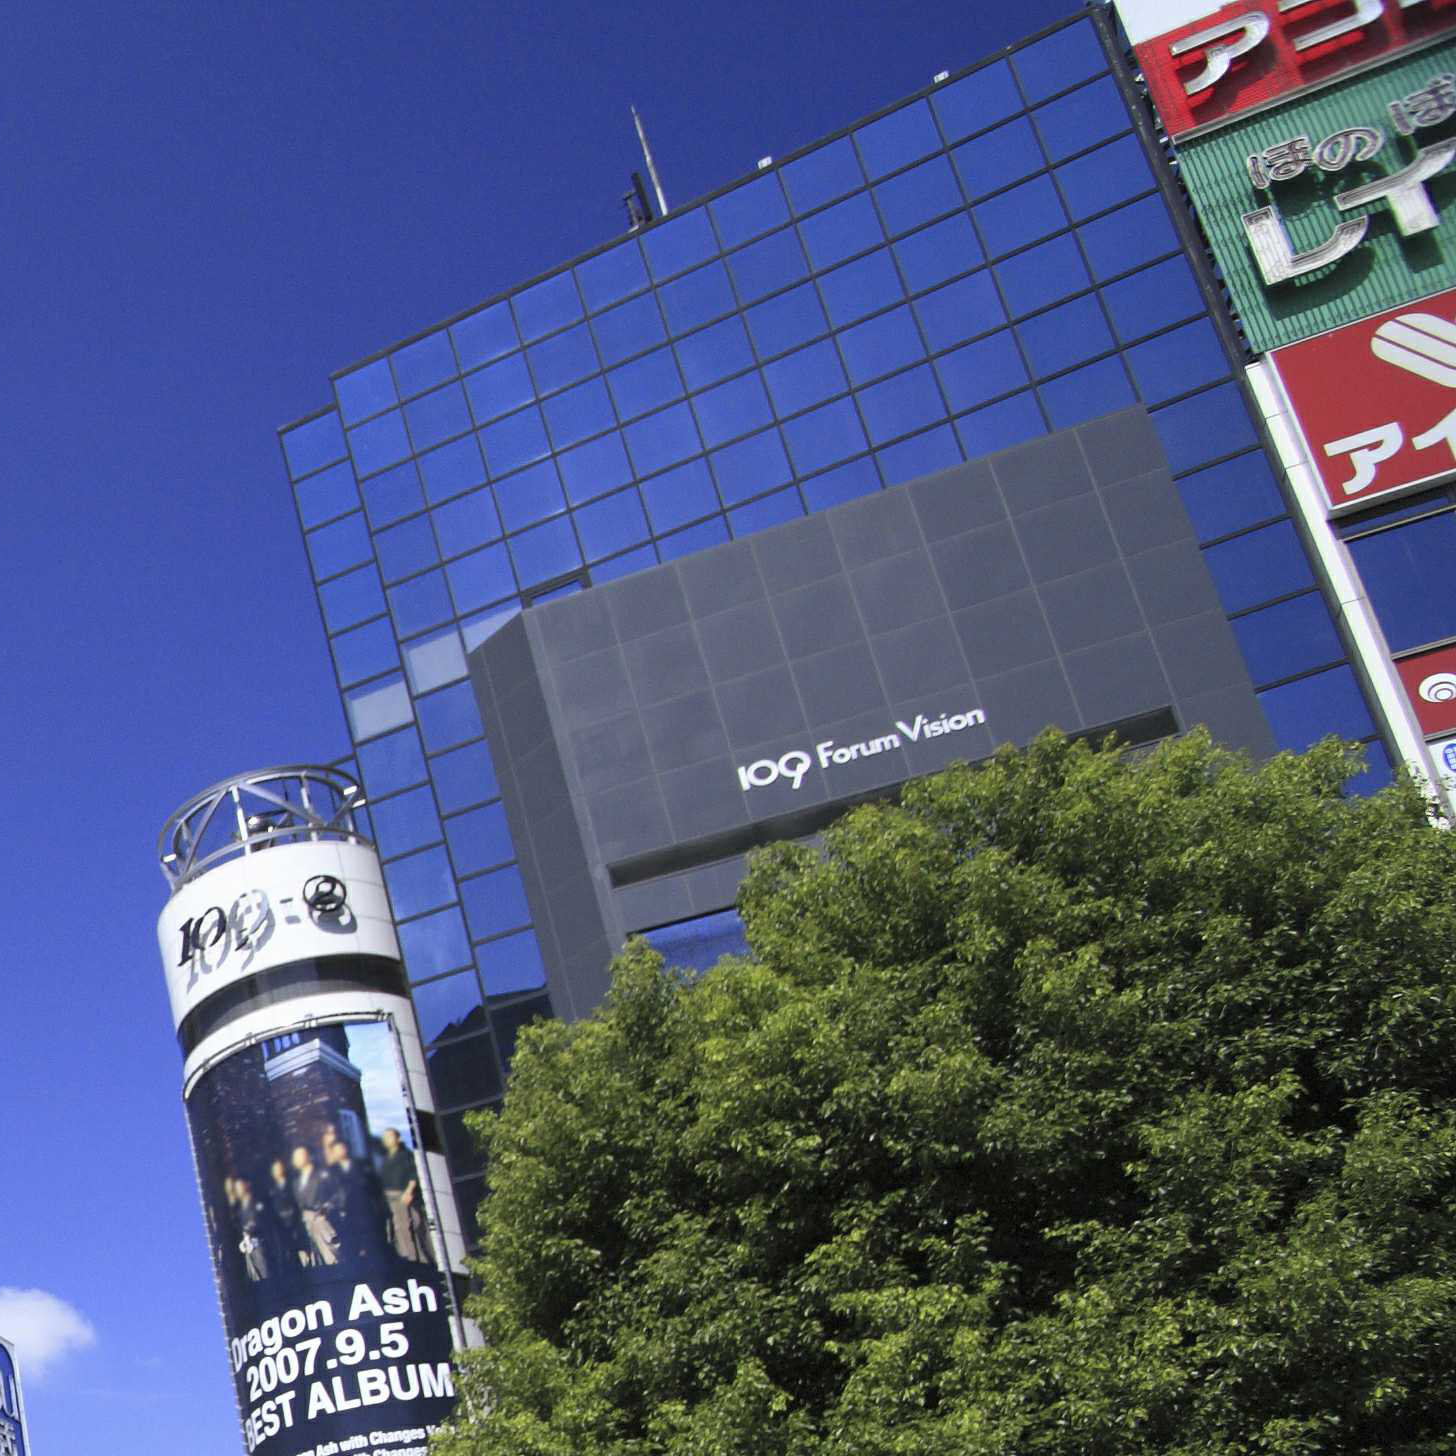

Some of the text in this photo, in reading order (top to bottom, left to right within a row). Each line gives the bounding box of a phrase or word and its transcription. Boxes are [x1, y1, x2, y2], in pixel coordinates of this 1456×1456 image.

[1171, 0, 1389, 96] アコ
[737, 708, 986, 791] 109 Forum Vision
[230, 1277, 437, 1375] Dragon Ash
[245, 1321, 410, 1403] 2007.9.5
[243, 1362, 456, 1454] BEST ALBUM
[339, 1435, 368, 1452] with
[369, 1426, 426, 1447] Changes
